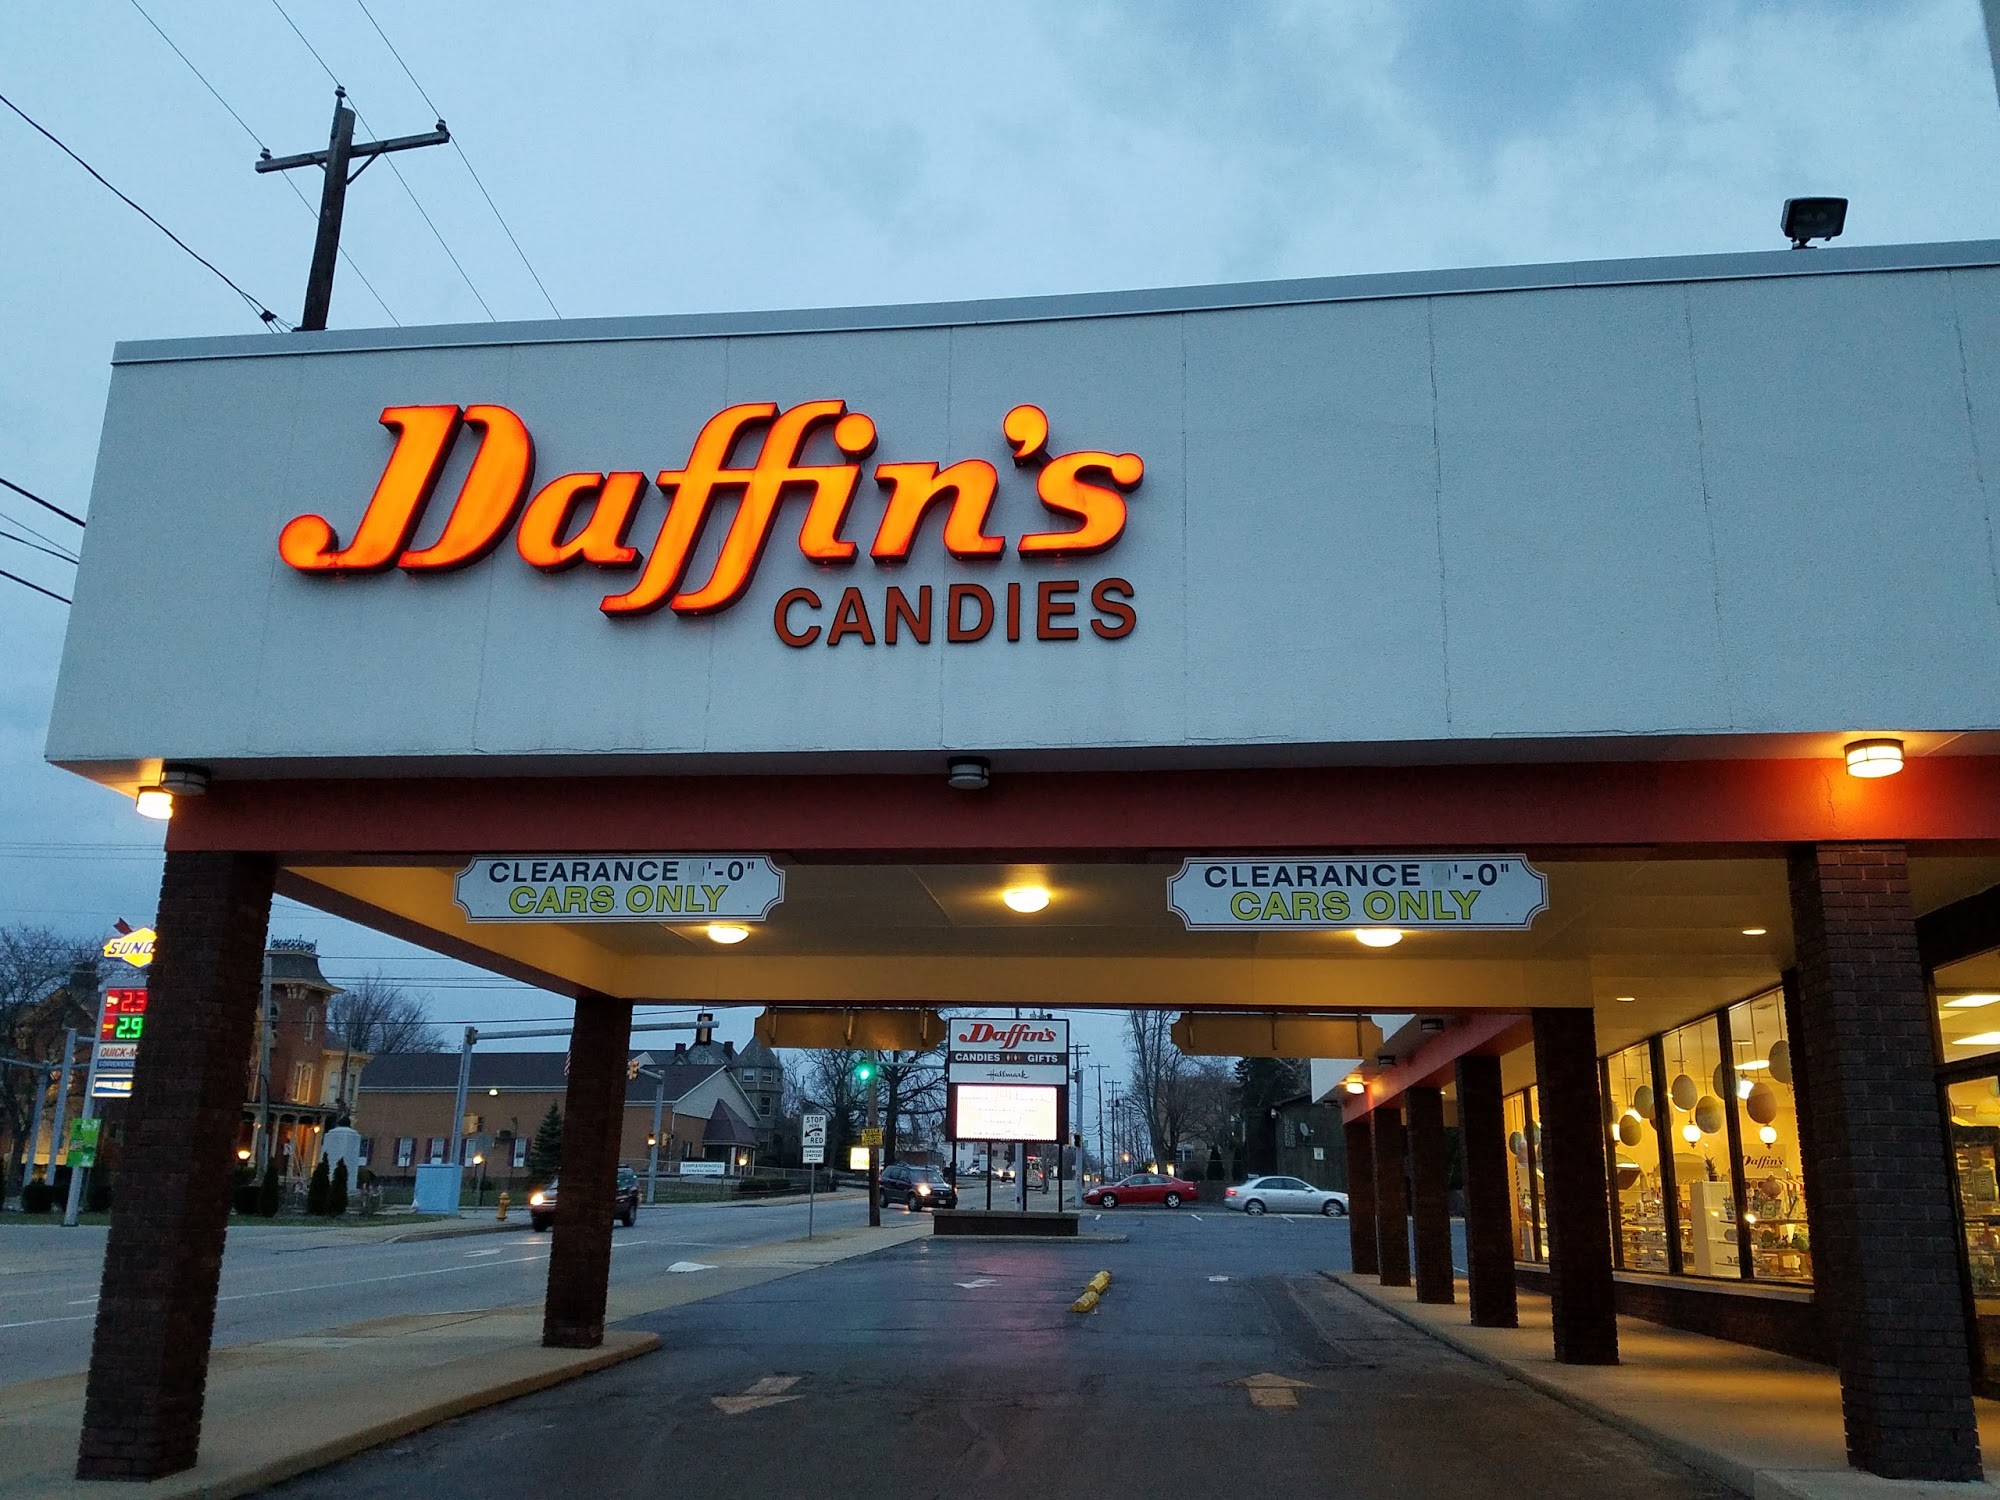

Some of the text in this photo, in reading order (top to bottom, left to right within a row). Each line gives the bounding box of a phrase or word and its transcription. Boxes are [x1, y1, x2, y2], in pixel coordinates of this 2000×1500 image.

[278, 400, 1145, 618] Daffin's
[773, 577, 1138, 648] CANDIES
[488, 861, 680, 883] CLEARANCE
[1204, 864, 1421, 888] CLEARANCE
[508, 884, 730, 914] CARS ONLY
[1230, 890, 1481, 921] CARS ONLY
[958, 1023, 1057, 1049] Daffin's
[955, 1053, 1058, 1063] CANDIES GIFTS
[986, 1069, 1030, 1081] Hallmark
